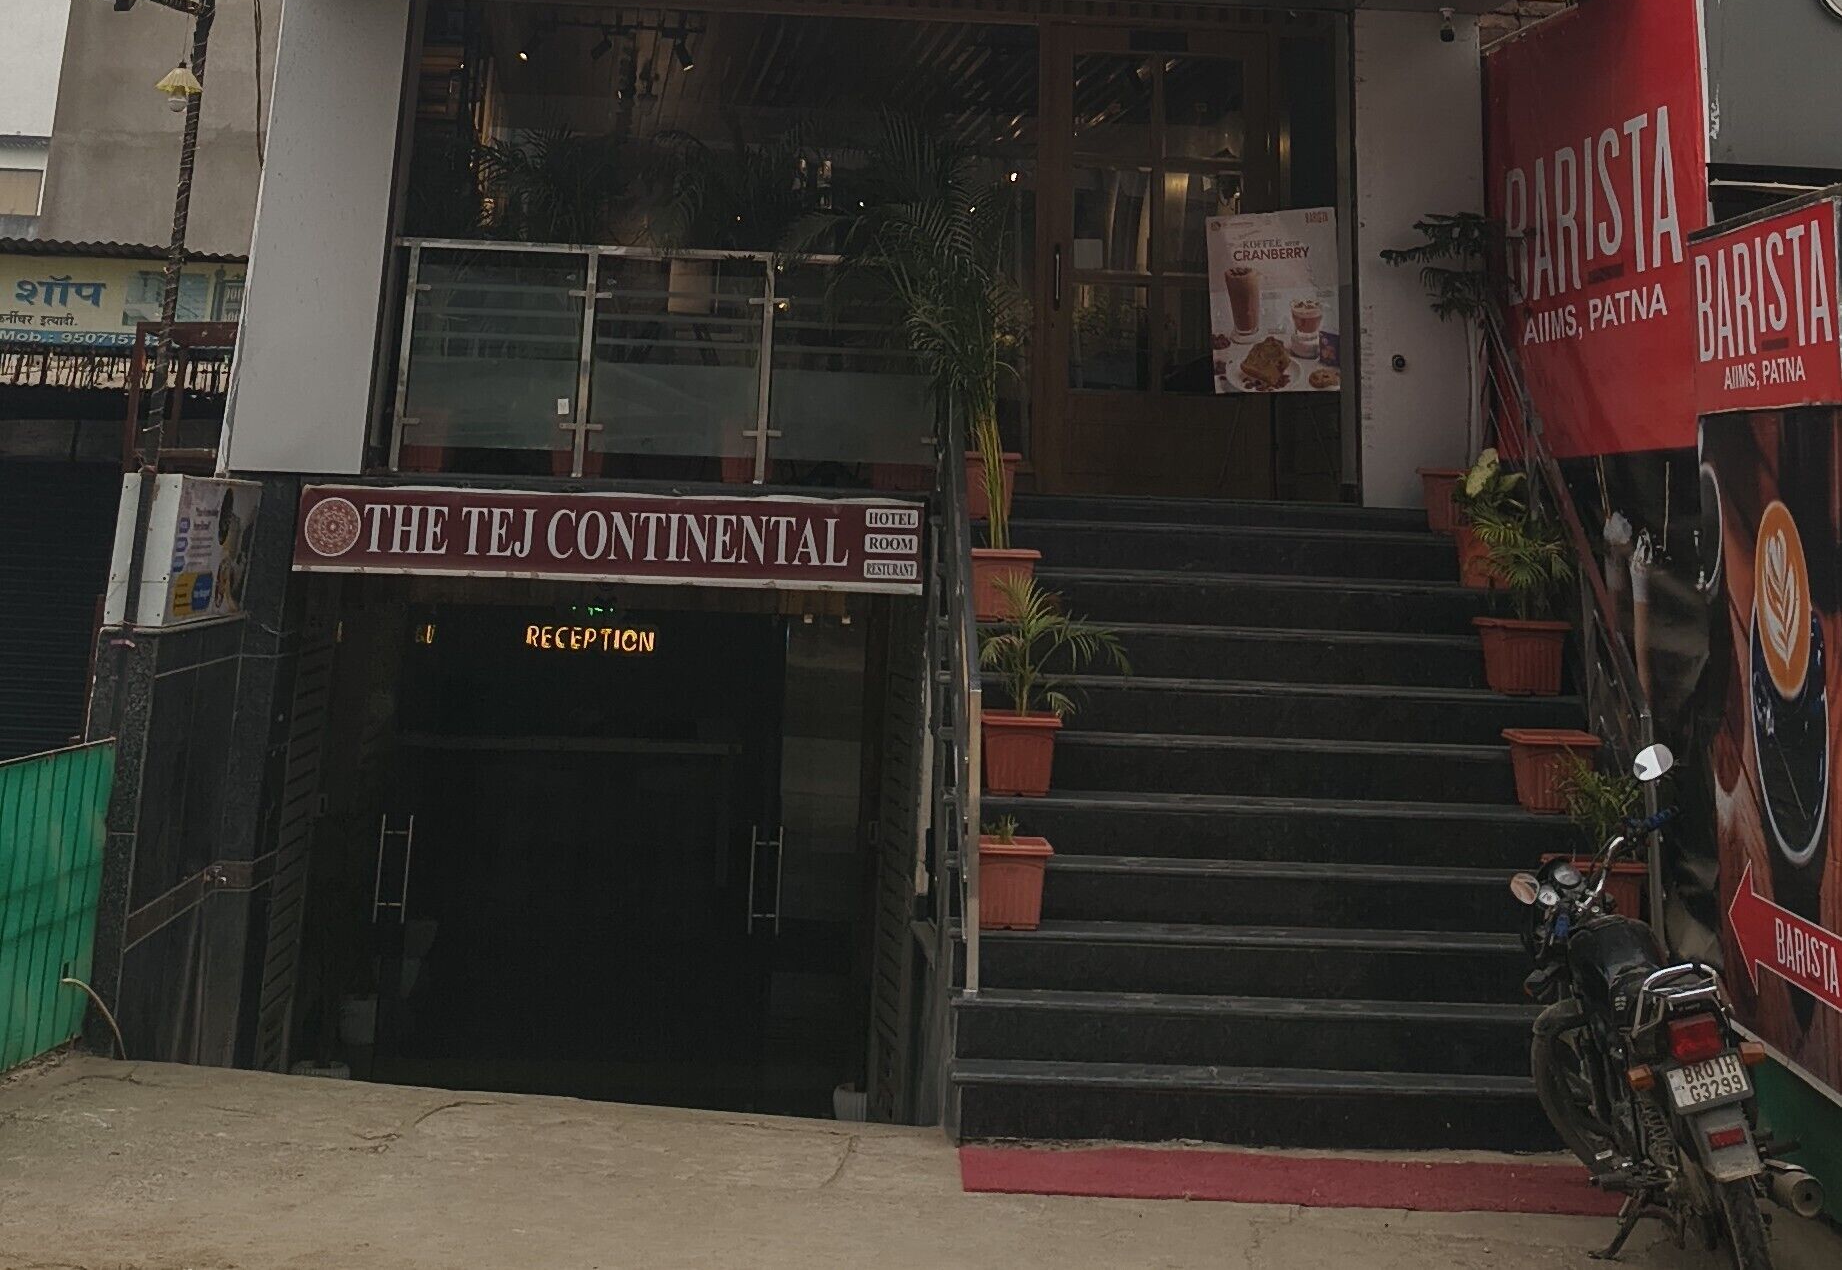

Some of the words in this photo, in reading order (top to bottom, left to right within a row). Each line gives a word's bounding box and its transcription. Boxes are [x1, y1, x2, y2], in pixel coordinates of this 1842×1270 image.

[1504, 105, 1683, 307] BARISTA
[1233, 246, 1310, 261] CRANBERRY
[15, 275, 107, 308] शॉप
[1695, 219, 1833, 363] BARISTA
[1524, 304, 1583, 346] AIIMS,
[1589, 283, 1668, 331] PATNA
[1724, 363, 1760, 390] AIIMS,
[1762, 355, 1806, 385] PATNA
[363, 503, 449, 555] THE
[461, 506, 538, 558] TEJ
[547, 509, 849, 568] CONTINENTAL
[868, 512, 917, 526] HOTEL
[868, 536, 914, 551] ROOM
[526, 624, 656, 652] RECEPTION
[1775, 917, 1841, 998] BARISTA
